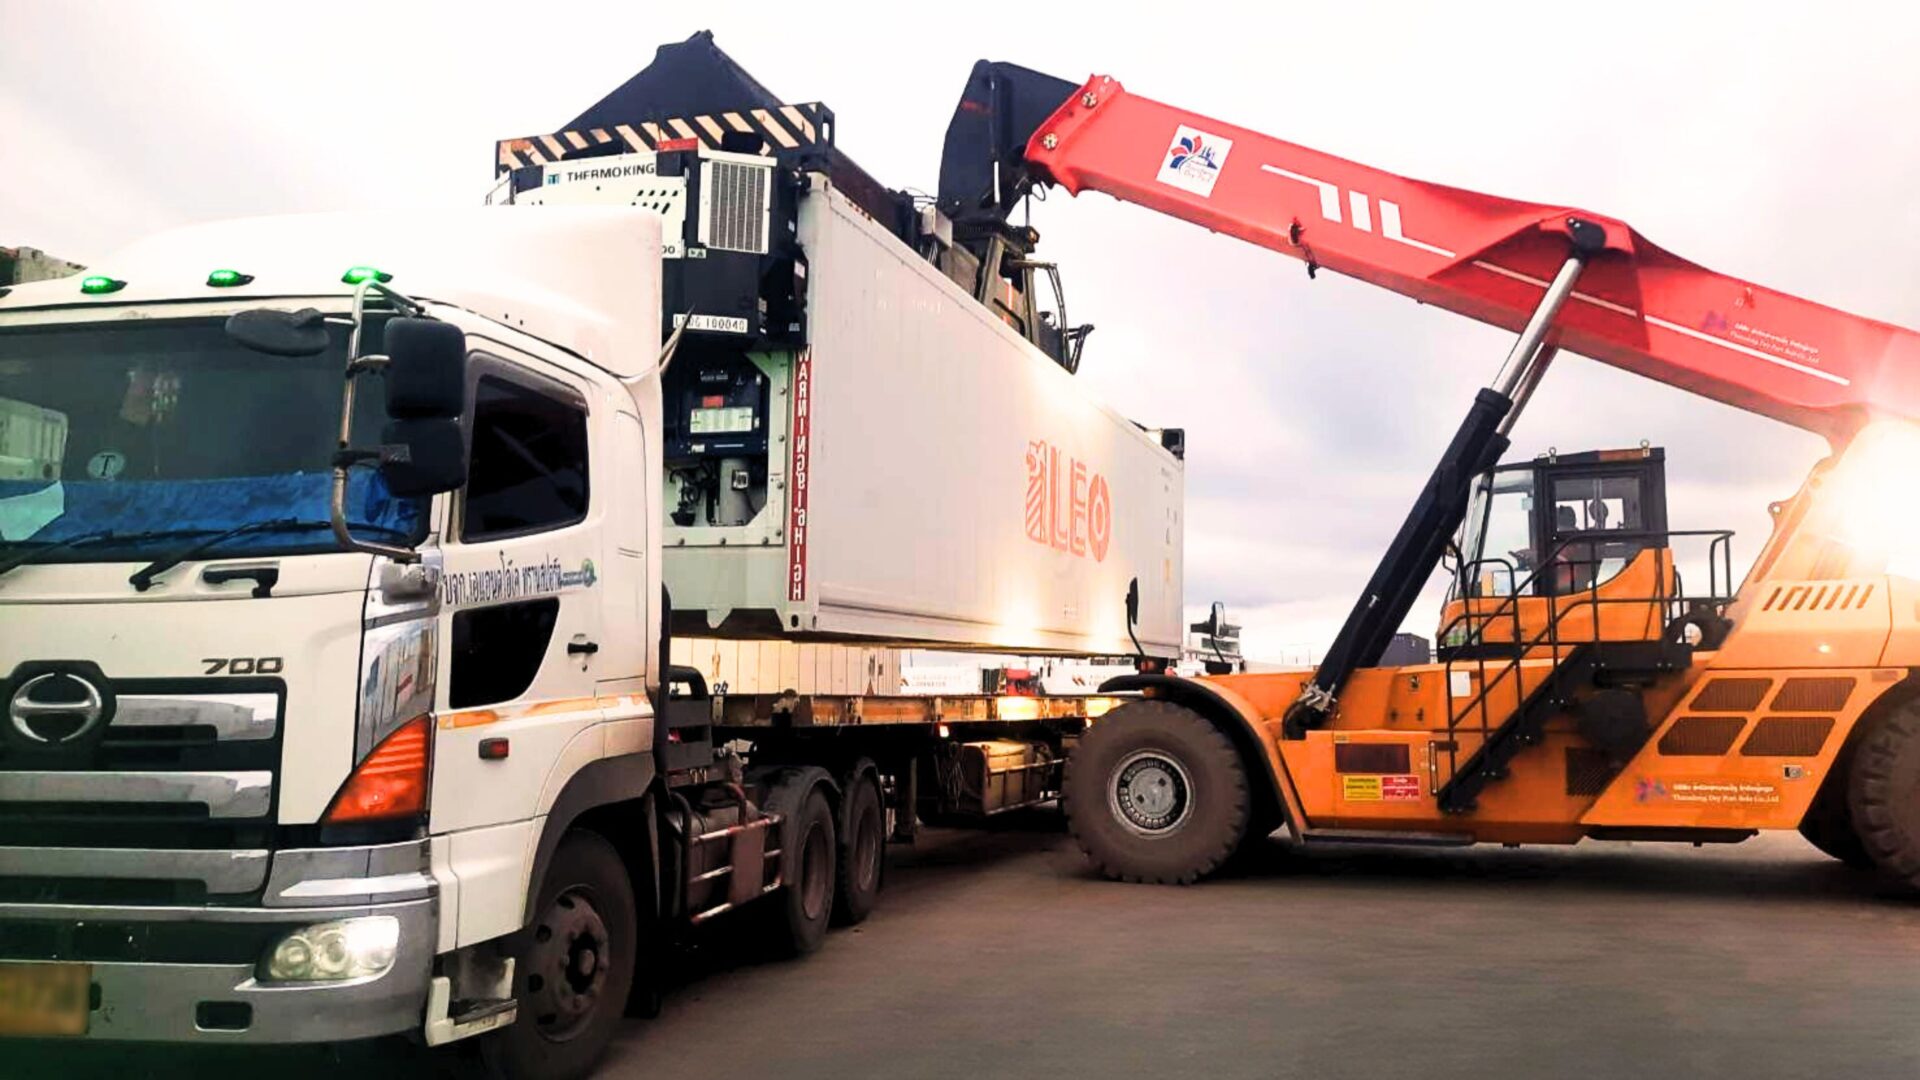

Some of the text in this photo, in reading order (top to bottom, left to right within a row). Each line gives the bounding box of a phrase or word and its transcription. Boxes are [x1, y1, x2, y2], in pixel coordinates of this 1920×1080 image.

[567, 163, 655, 182] THERMO KING
[1049, 445, 1112, 563] LEO
[201, 657, 284, 675] 700
